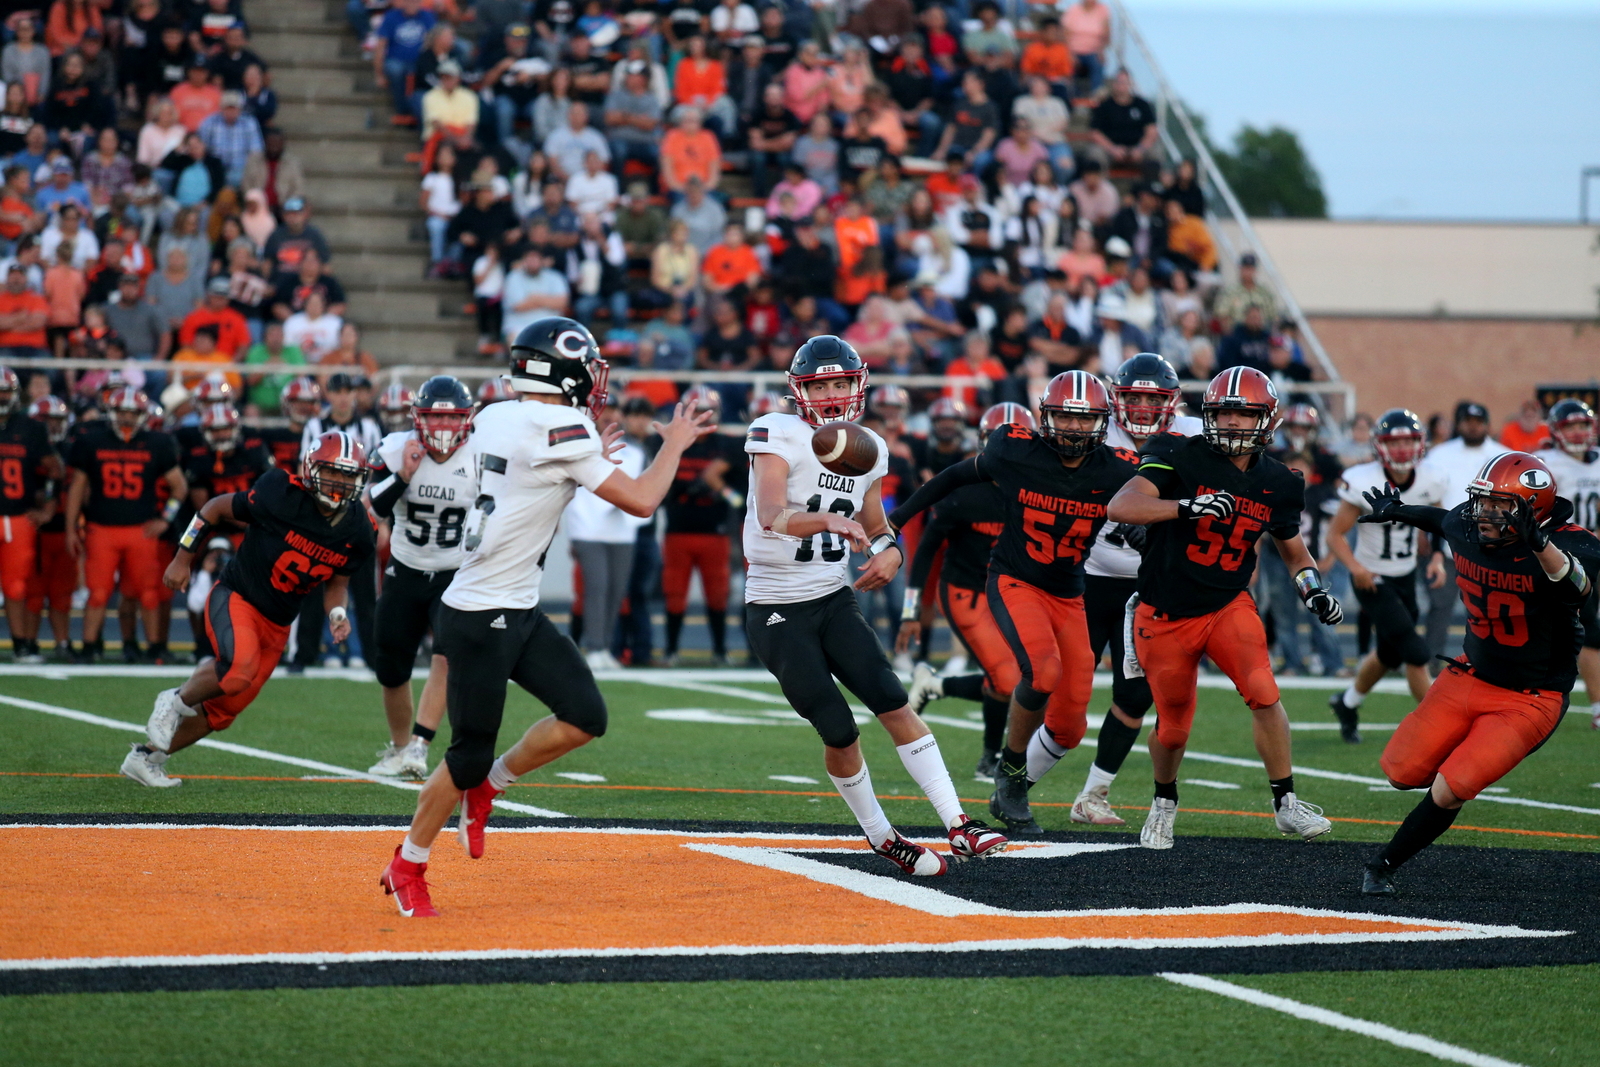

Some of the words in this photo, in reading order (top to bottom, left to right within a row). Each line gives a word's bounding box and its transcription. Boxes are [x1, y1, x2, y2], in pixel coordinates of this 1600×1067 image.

[101, 462, 145, 499] 65
[418, 485, 456, 500] COZAD
[818, 472, 855, 493] COZAD
[1524, 470, 1548, 488] L
[1018, 488, 1109, 518] MINUTEMEN
[405, 501, 466, 548] 58
[1022, 506, 1093, 566] 54
[1186, 513, 1263, 572] 55
[1453, 551, 1534, 593] MINUTEMEN
[1455, 575, 1529, 647] 50
